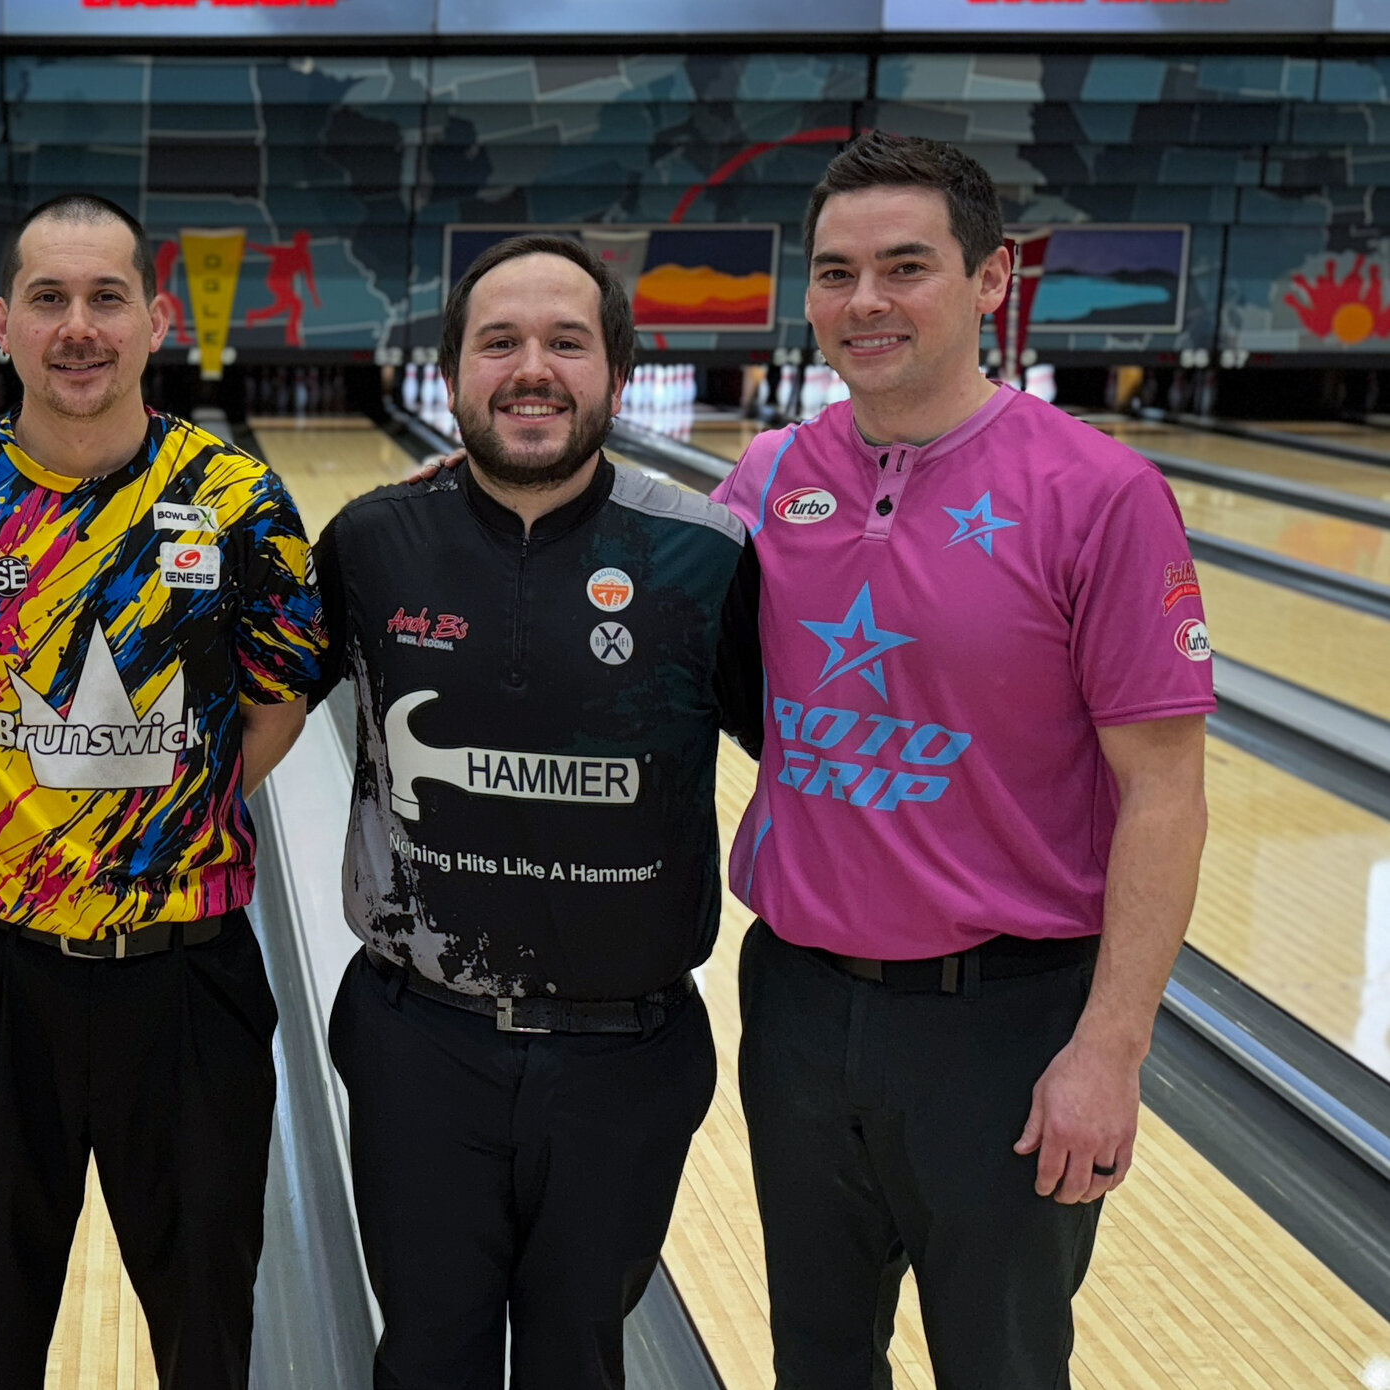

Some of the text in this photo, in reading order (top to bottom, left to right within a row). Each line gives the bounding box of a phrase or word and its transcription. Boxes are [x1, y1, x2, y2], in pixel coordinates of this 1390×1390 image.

[787, 499, 830, 515] Turbo
[165, 571, 216, 585] GENESIS
[592, 568, 630, 584] EXQUISITE
[387, 607, 469, 647] Andy B's
[423, 638, 454, 652] SOCIAL
[773, 697, 972, 766] ROTO
[467, 751, 630, 797] HAMMER
[777, 749, 951, 811] GRIP
[457, 852, 498, 874] Hits
[503, 857, 545, 880] Like
[550, 862, 565, 880] A
